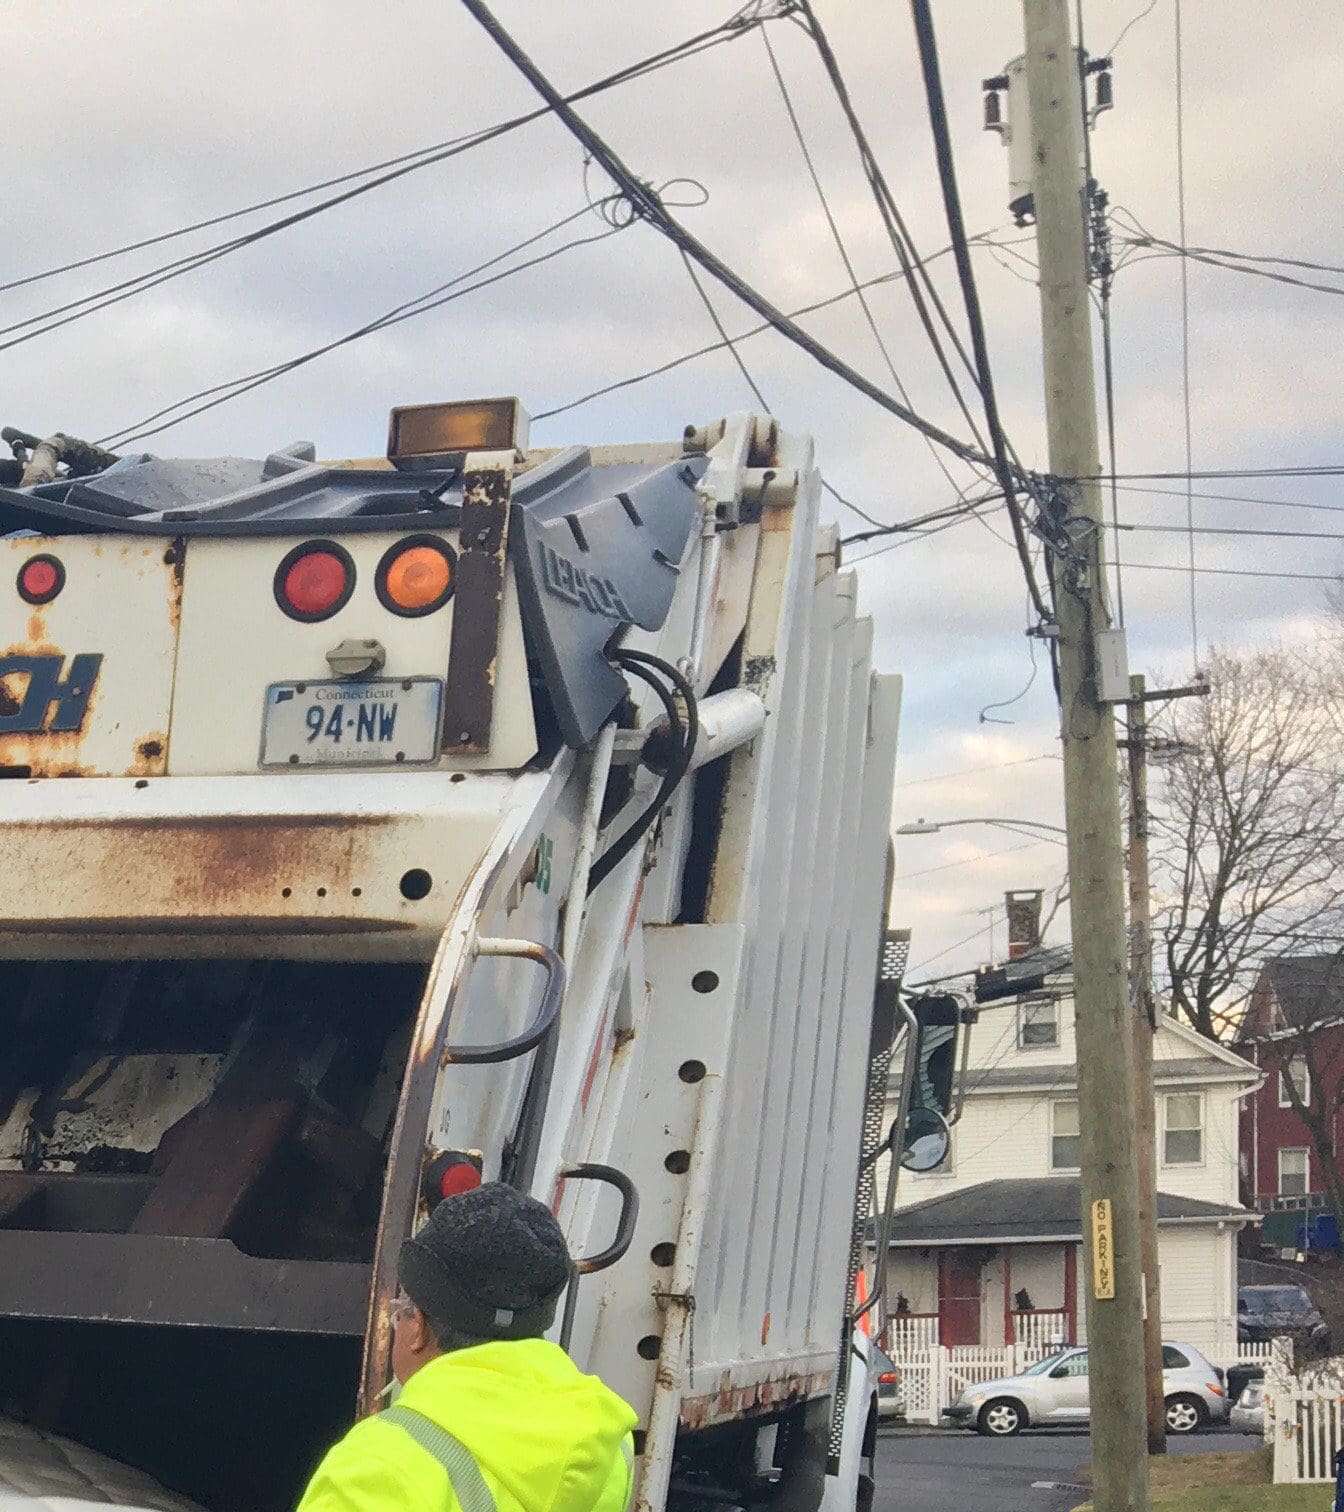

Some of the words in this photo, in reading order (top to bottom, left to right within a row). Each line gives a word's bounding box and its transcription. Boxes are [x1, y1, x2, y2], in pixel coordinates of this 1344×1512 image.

[537, 539, 634, 621] LEACH
[315, 688, 395, 701] Connecticut
[1097, 1201, 1106, 1220] NO
[1097, 1224, 1109, 1289] PARKING
